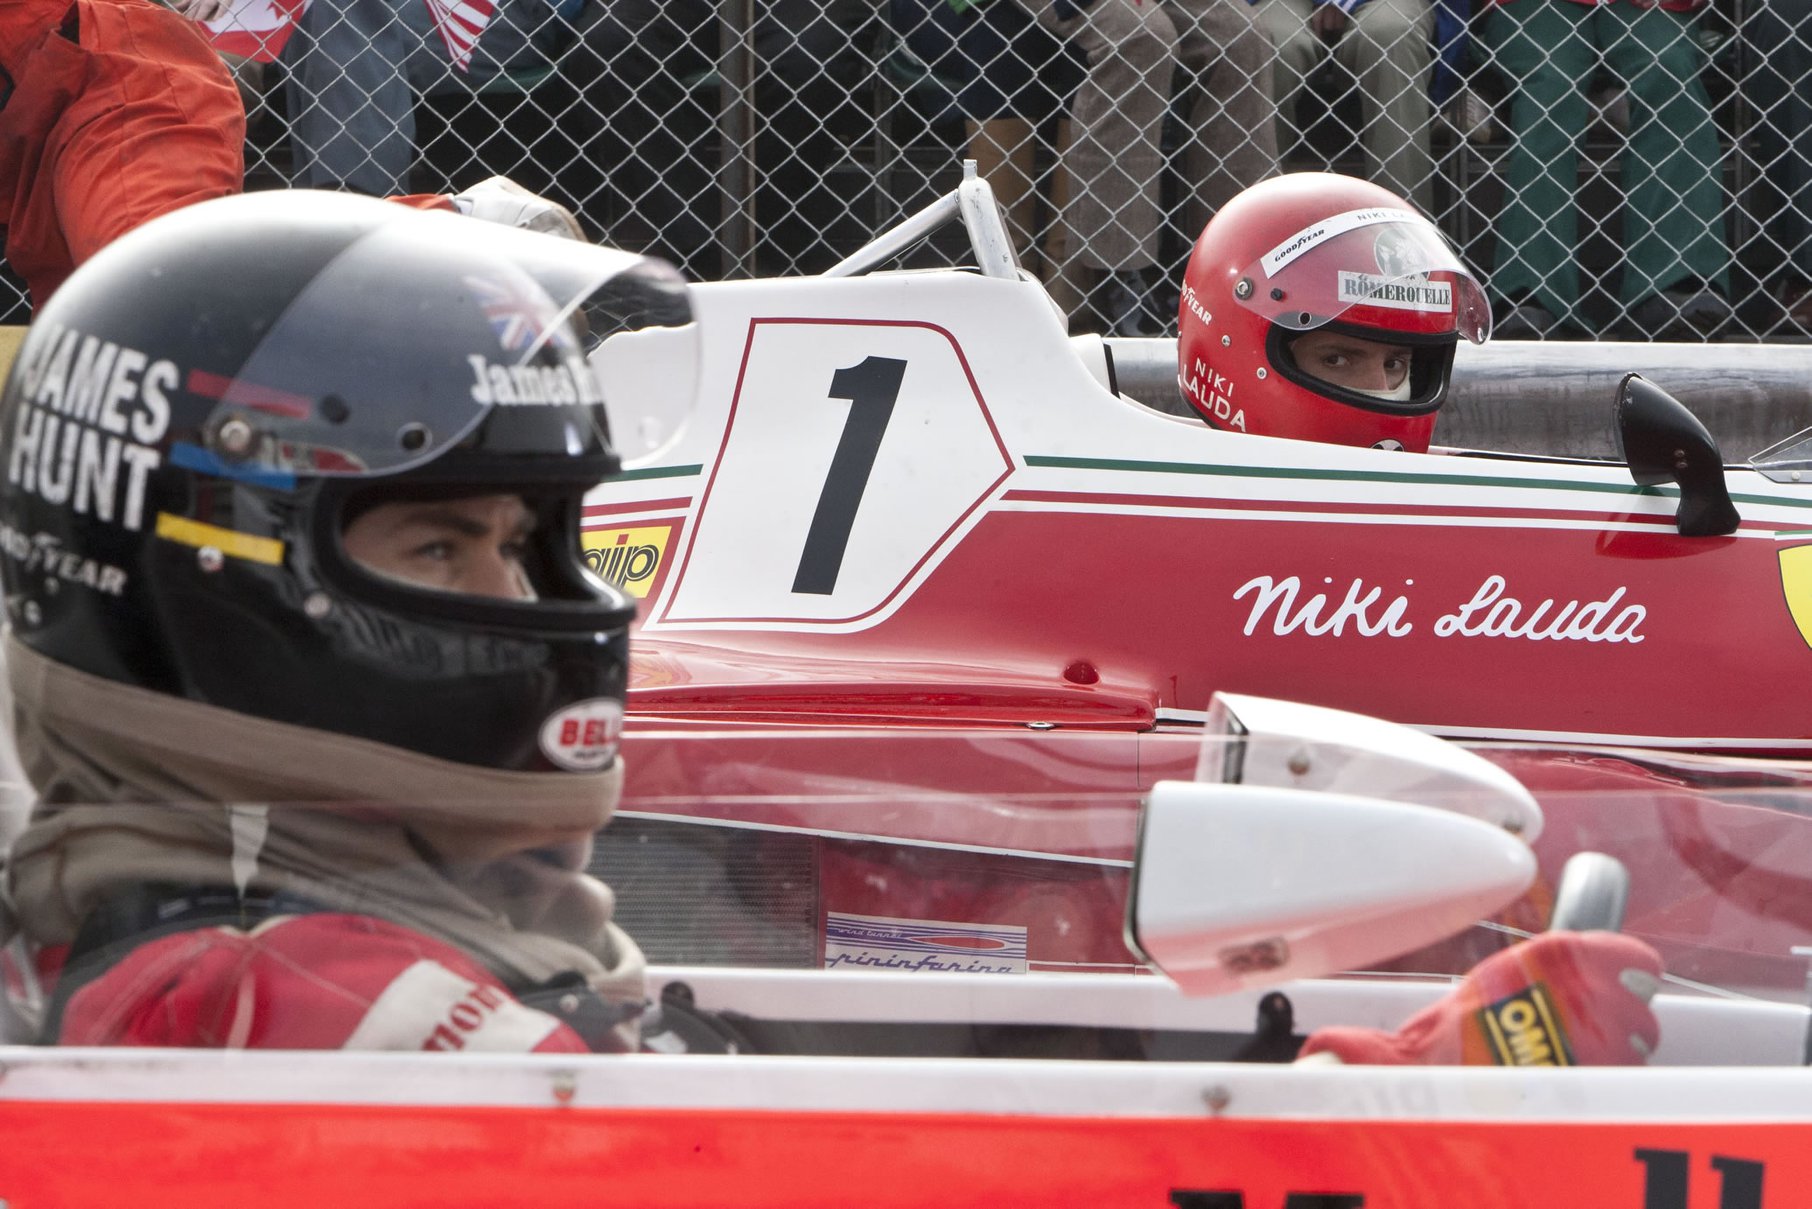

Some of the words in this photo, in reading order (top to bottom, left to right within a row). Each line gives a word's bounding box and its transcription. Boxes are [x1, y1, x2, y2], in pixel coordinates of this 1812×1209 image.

[1274, 229, 1325, 262] GOODYEAR
[16, 323, 179, 444] JAMES
[467, 353, 578, 408] James
[1183, 364, 1246, 433] LAUDA
[1195, 357, 1234, 397] NIKI
[9, 402, 161, 532] HUNT
[791, 355, 908, 595] 1
[1233, 575, 1413, 637] Niki
[1433, 575, 1647, 644] Lauda
[1500, 999, 1556, 1067] OM
